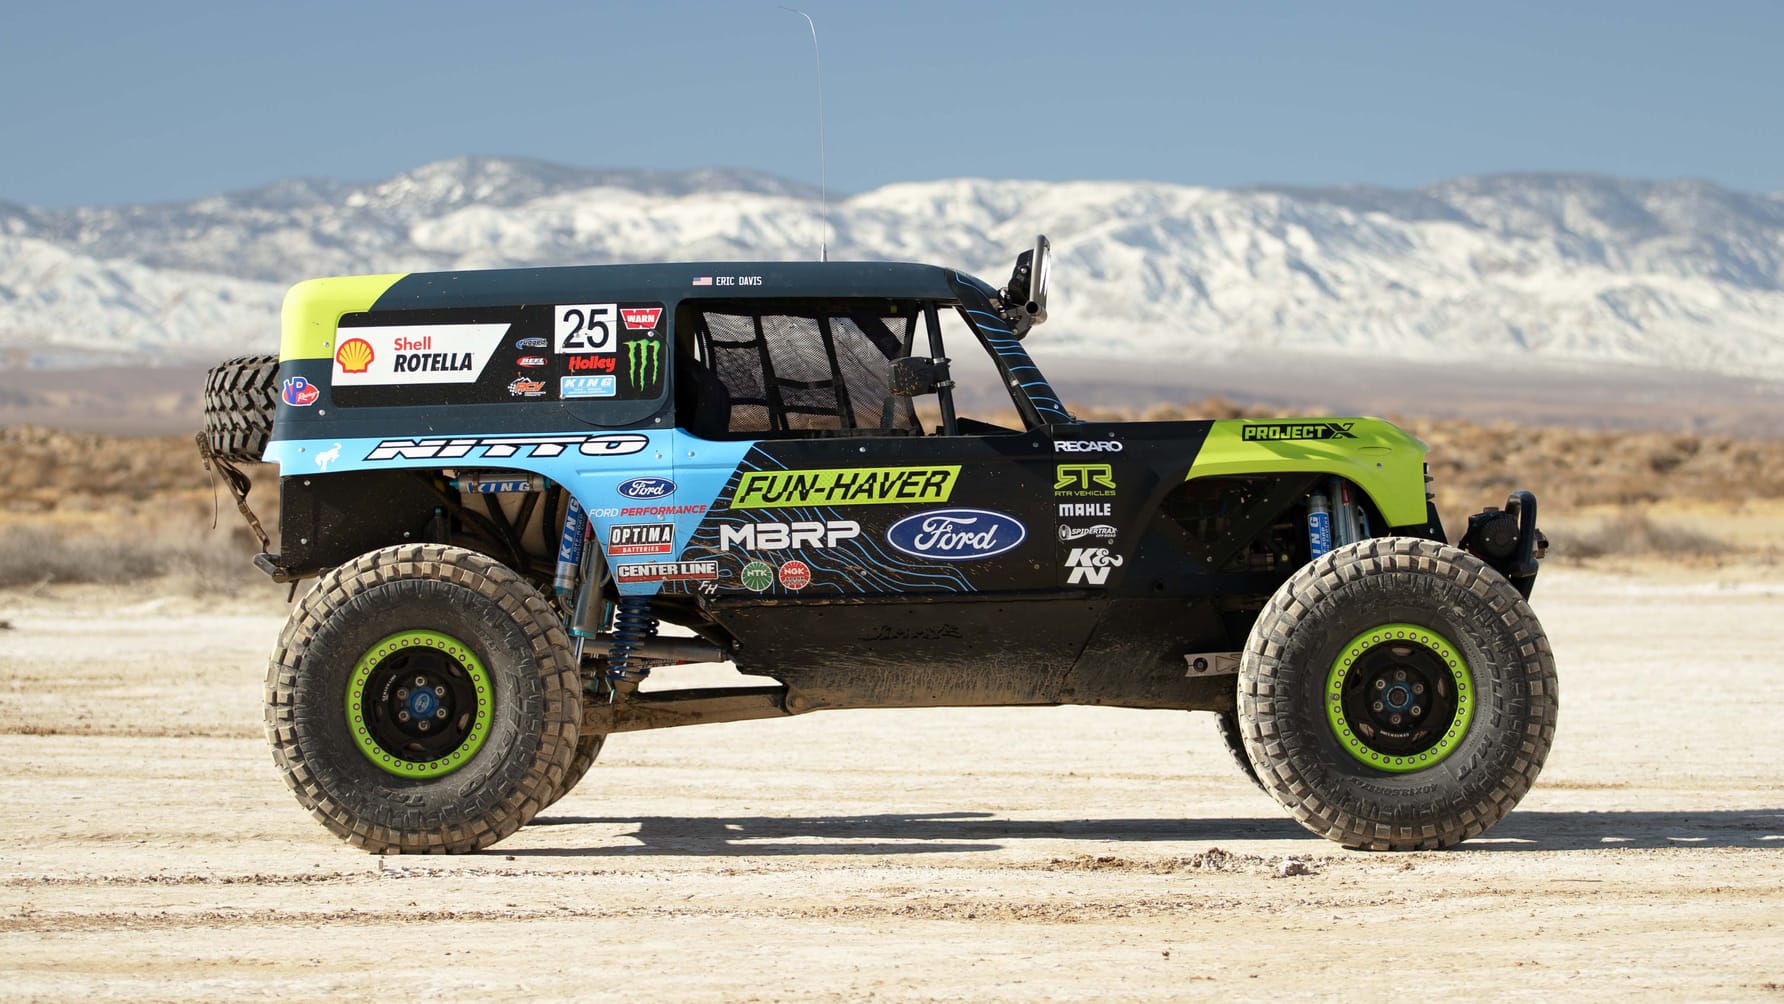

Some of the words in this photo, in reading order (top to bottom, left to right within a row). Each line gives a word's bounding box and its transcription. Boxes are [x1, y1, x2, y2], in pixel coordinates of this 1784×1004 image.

[716, 276, 735, 286] ERIC
[738, 276, 762, 286] DAVIS
[627, 313, 656, 324] WARN
[561, 308, 610, 349] 25
[394, 336, 431, 351] Shell
[393, 352, 473, 372] ROTELLA
[568, 355, 616, 373] Holley
[284, 377, 308, 405] VP
[564, 378, 614, 389] KING
[1244, 426, 1327, 440] PROJECT
[362, 433, 651, 462] NITTO
[1053, 440, 1123, 452] RECARO
[628, 480, 665, 496] Ford
[738, 470, 950, 504] FUN-HAVER
[589, 508, 618, 518] FORD
[620, 504, 707, 517] PERFORMANCE
[1059, 503, 1111, 517] MAHLE
[612, 526, 671, 544] OPTIMA
[720, 520, 861, 551] MBRP
[914, 516, 997, 551] Ford
[1309, 516, 1321, 559] ING
[622, 545, 659, 553] BATTERIES
[618, 564, 678, 577] CENTER
[680, 563, 716, 575] LINE
[747, 569, 767, 577] NTK
[699, 580, 718, 595] FH
